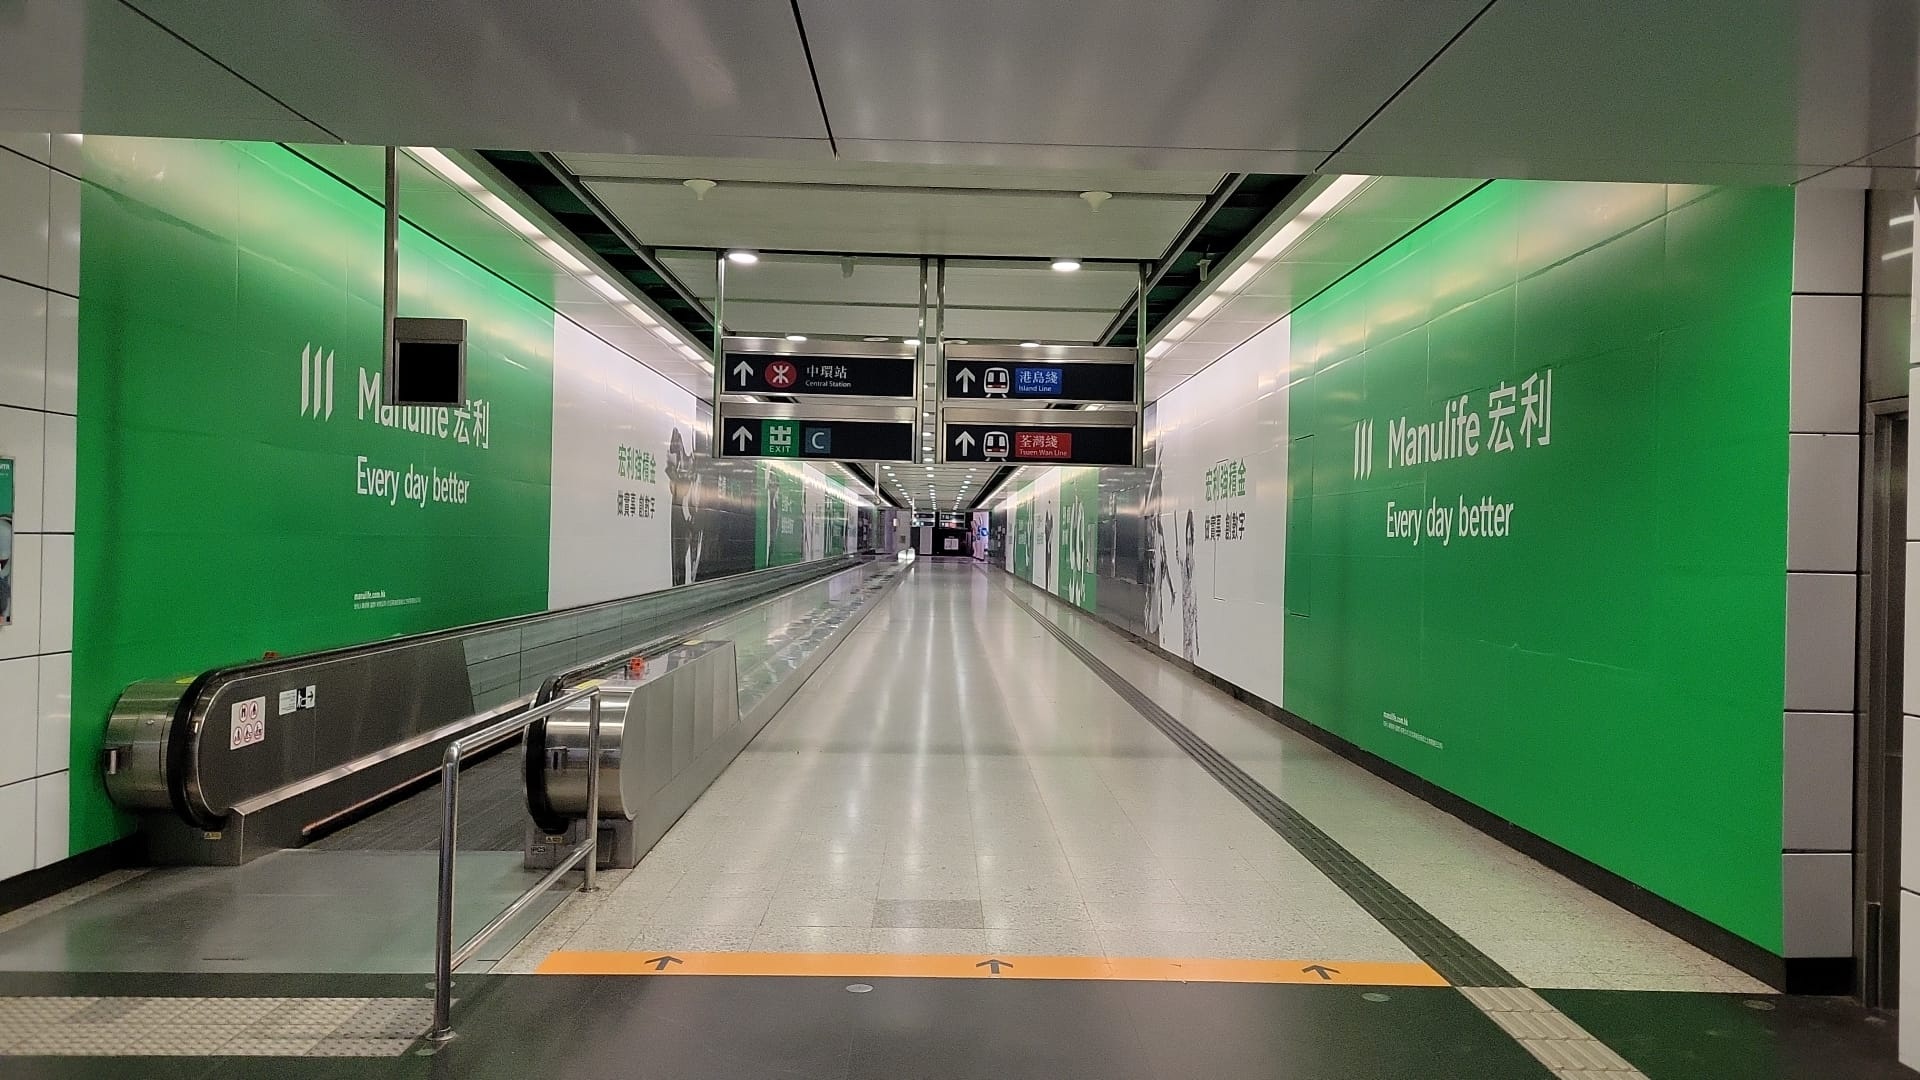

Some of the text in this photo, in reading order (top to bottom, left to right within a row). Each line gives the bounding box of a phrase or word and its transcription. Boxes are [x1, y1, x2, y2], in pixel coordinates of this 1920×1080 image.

[806, 364, 848, 379] 中環站
[1019, 370, 1058, 384] 港島綫
[829, 380, 852, 388] Station
[453, 399, 490, 450] 宏利
[1388, 368, 1552, 469] Manulife 宏利
[811, 432, 825, 449] C
[1020, 434, 1058, 448] 荃灣綫
[769, 445, 791, 453] EXIT
[357, 455, 470, 508] Every day better
[1386, 494, 1514, 546] Every day better
